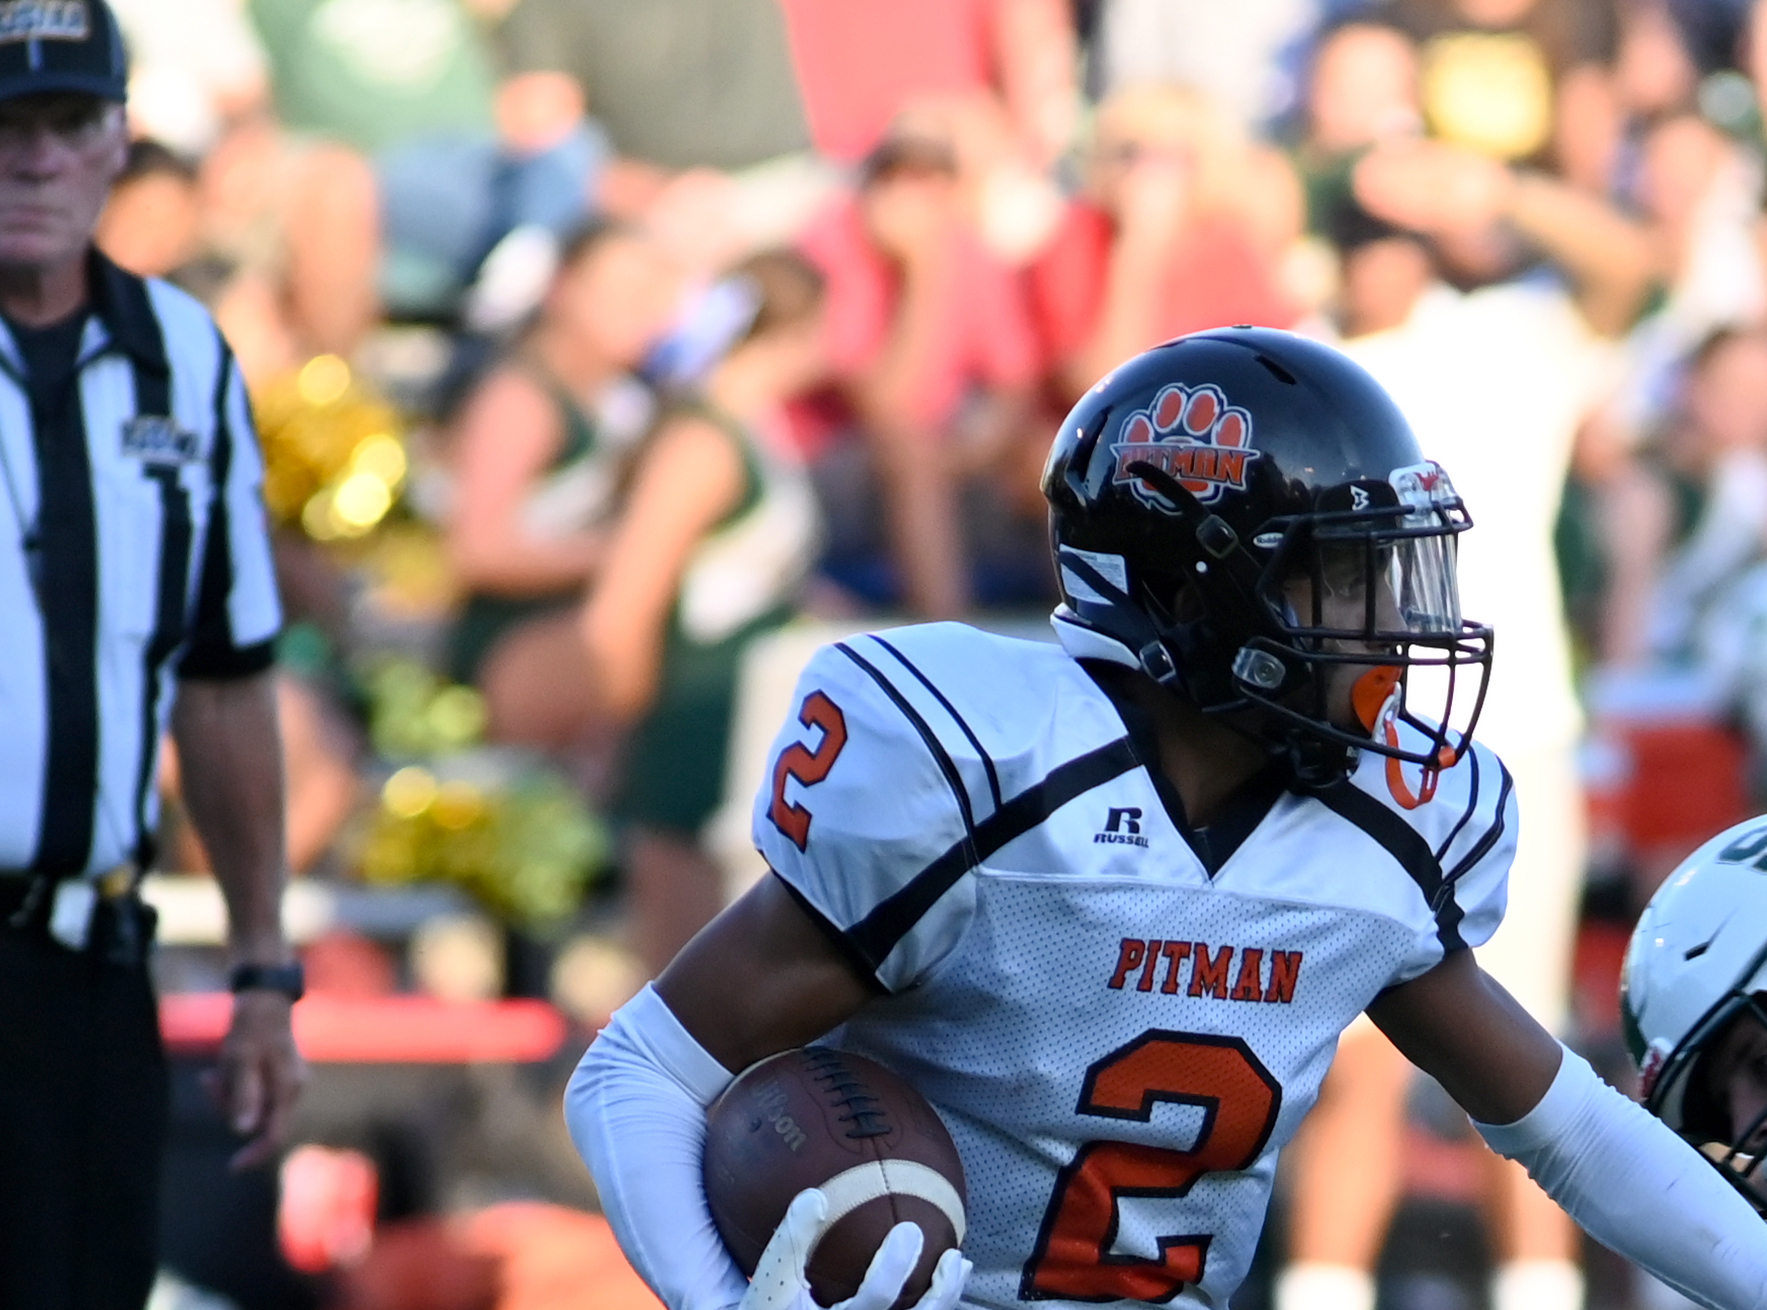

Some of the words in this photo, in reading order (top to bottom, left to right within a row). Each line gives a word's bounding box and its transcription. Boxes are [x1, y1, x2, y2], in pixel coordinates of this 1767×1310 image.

[766, 689, 848, 853] 2
[1093, 833, 1149, 848] RUSSELL
[1108, 937, 1303, 1004] PITMAN
[1019, 1029, 1282, 1304] 2
